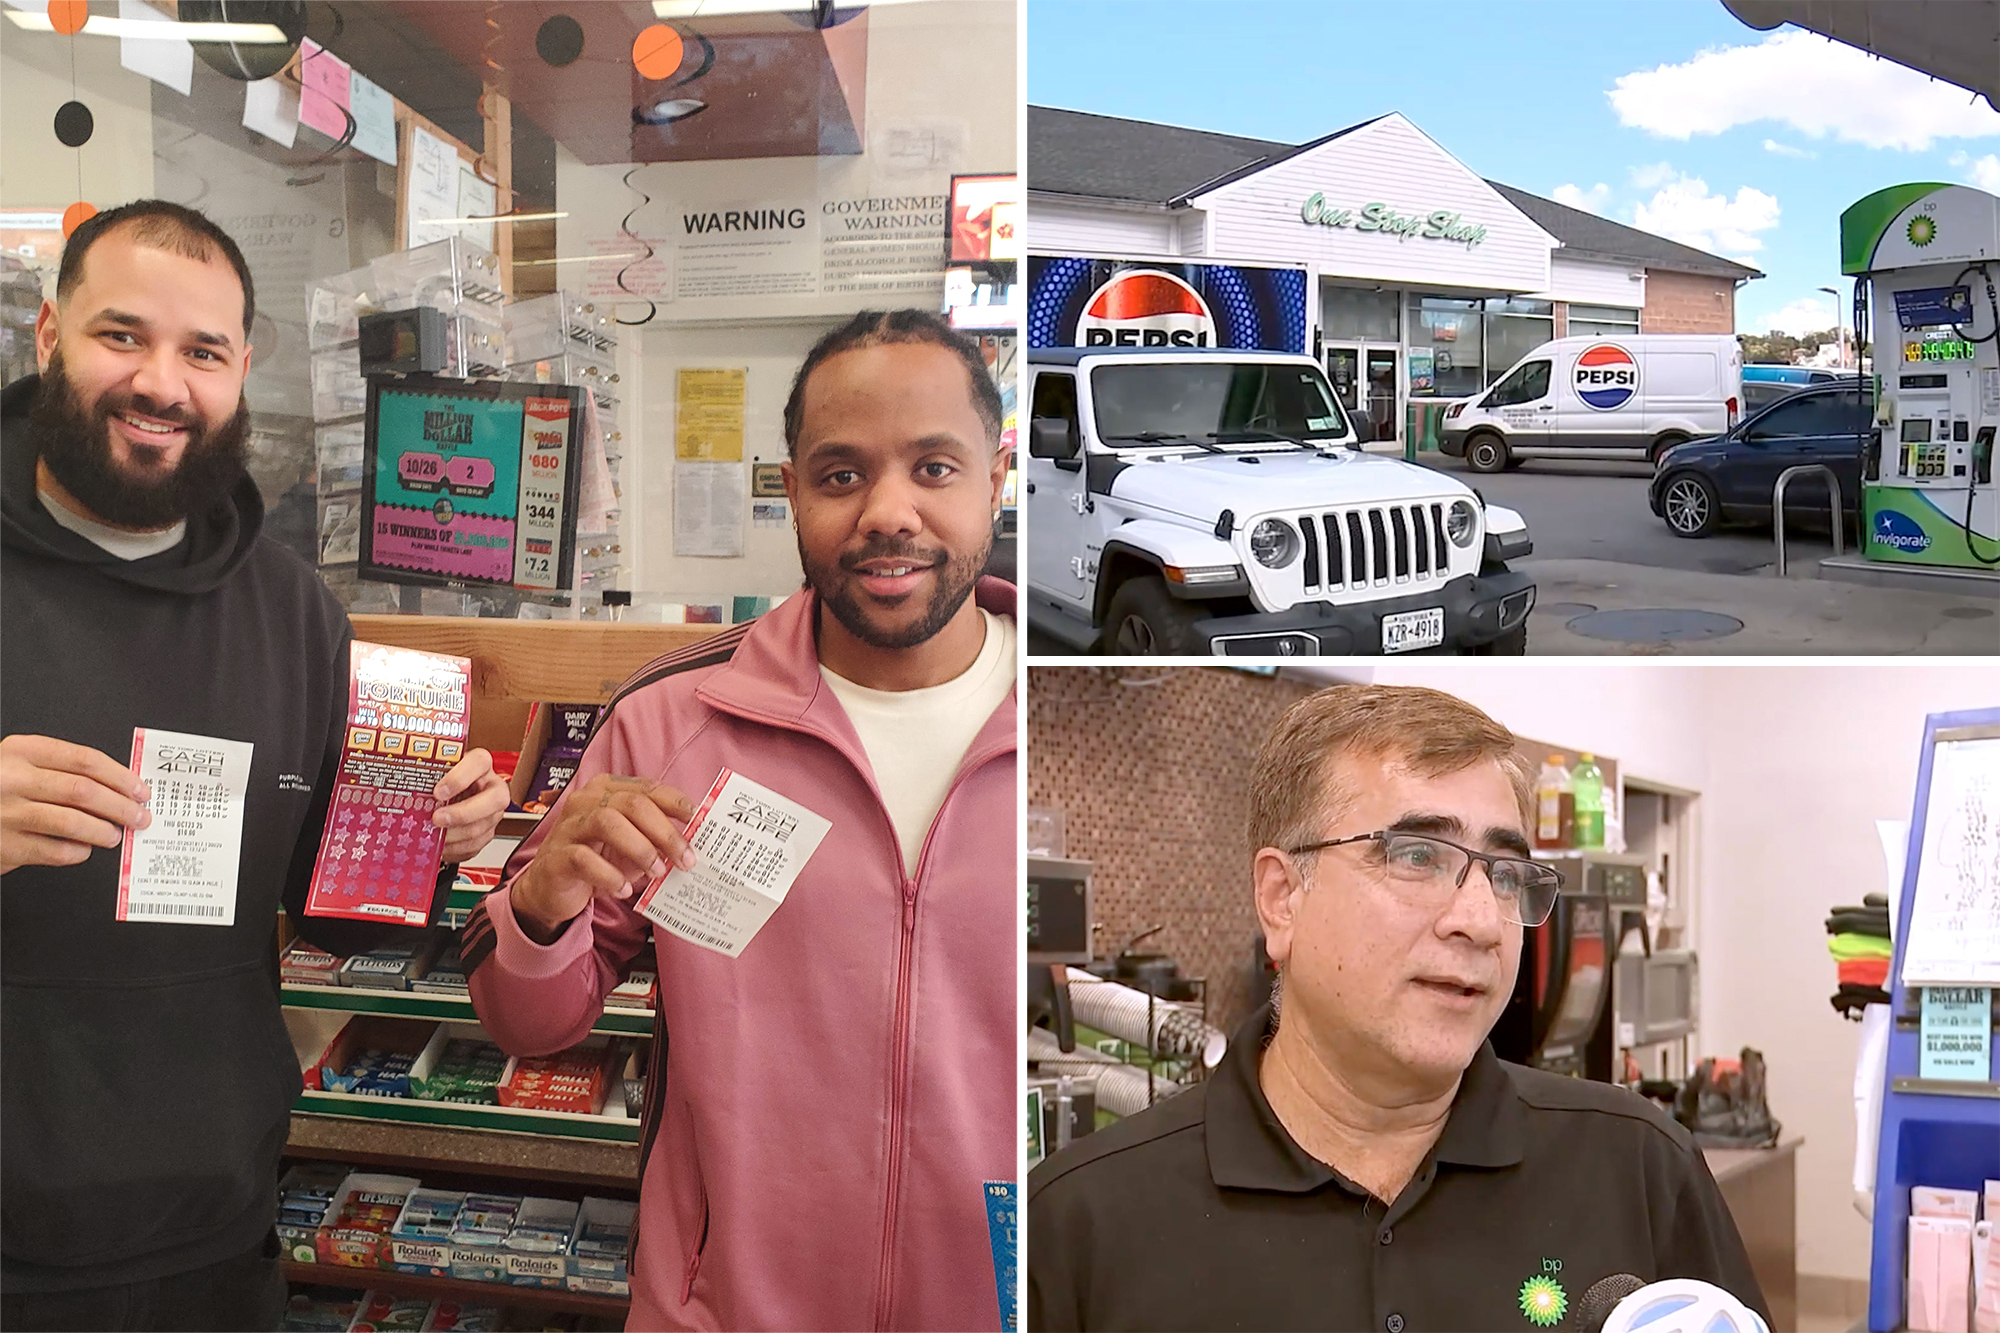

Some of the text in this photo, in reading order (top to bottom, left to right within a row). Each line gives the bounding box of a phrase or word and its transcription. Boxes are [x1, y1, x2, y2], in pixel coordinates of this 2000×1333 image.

[822, 196, 943, 215] GOVERNME
[1923, 203, 1937, 212] bp
[684, 208, 806, 234] WARNING
[844, 213, 943, 231] WARNING
[1302, 191, 1487, 250] One Stop Shop
[1576, 370, 1635, 385] PEPSI
[529, 402, 568, 413] JACKPOTS
[424, 411, 474, 430] MILLION
[423, 425, 473, 445] DOLLAR
[406, 459, 438, 475] 10/26
[466, 466, 474, 479] 2
[525, 503, 556, 520] $344
[377, 522, 388, 535] 15
[390, 523, 438, 541] WINNERS
[439, 529, 453, 543] OF
[525, 557, 550, 572] $7.2
[358, 679, 466, 714] FORTUNE
[358, 706, 377, 718] WIN
[564, 712, 591, 721] DAIRY
[354, 714, 379, 726] UP TO
[566, 719, 588, 728] MILK
[158, 749, 224, 766] CASH
[157, 762, 222, 778] 4LIFE
[549, 766, 574, 775] DAIRY
[734, 796, 798, 832] CASH
[727, 810, 791, 844] 4LIFE
[358, 959, 404, 968] ALTOIDS
[1928, 988, 1984, 1005] DOLLAR
[1927, 1042, 1983, 1052] $1,000,000
[551, 1074, 591, 1084] HALLS
[548, 1084, 590, 1096] HALLS
[988, 1186, 1008, 1197] $30
[397, 1244, 442, 1258] Rolaids
[452, 1250, 501, 1264] Rolaids
[511, 1258, 559, 1270] Rolaids
[1542, 1256, 1563, 1275] bp
